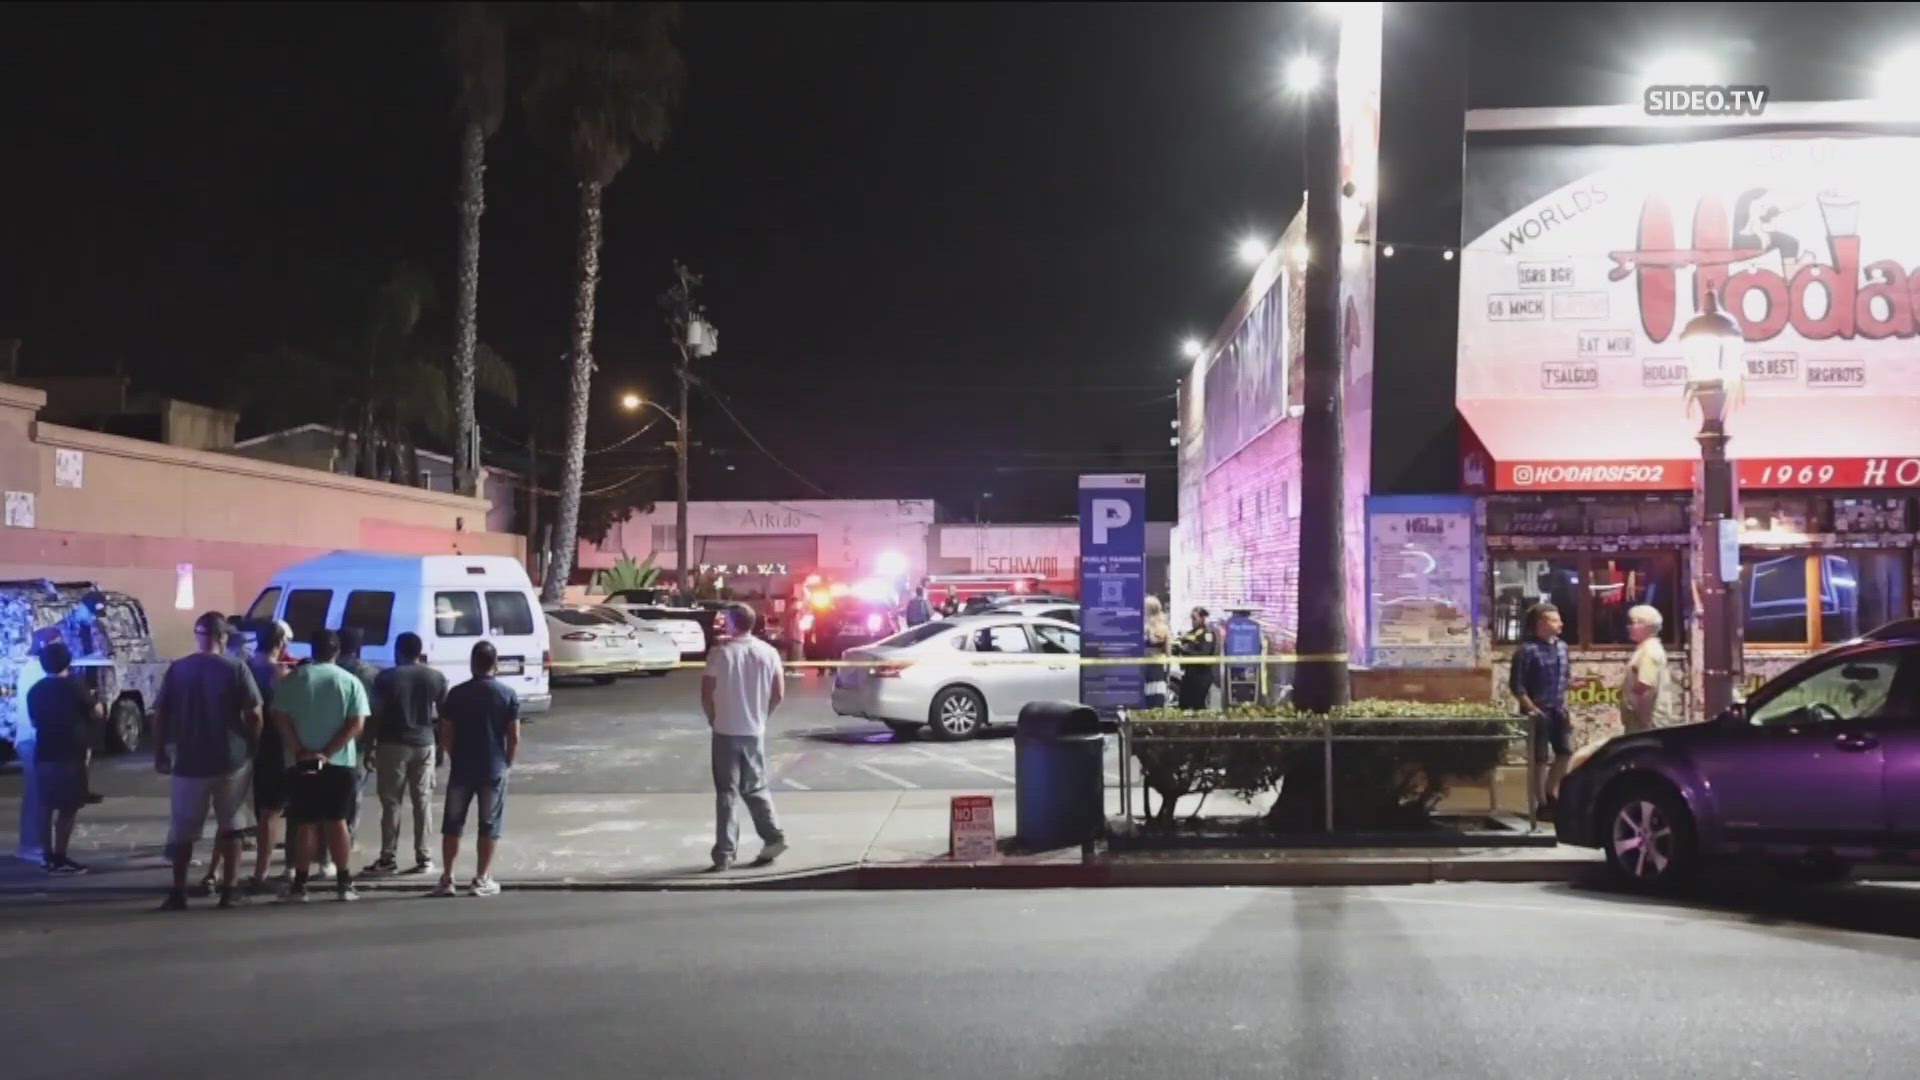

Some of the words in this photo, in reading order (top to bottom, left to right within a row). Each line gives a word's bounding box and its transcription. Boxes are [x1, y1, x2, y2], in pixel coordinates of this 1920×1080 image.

[1500, 184, 1608, 254] WORLDS
[1767, 359, 1796, 374] BEST
[1761, 465, 1834, 485] 1969
[741, 509, 801, 528] Aikido
[1092, 499, 1132, 544] P
